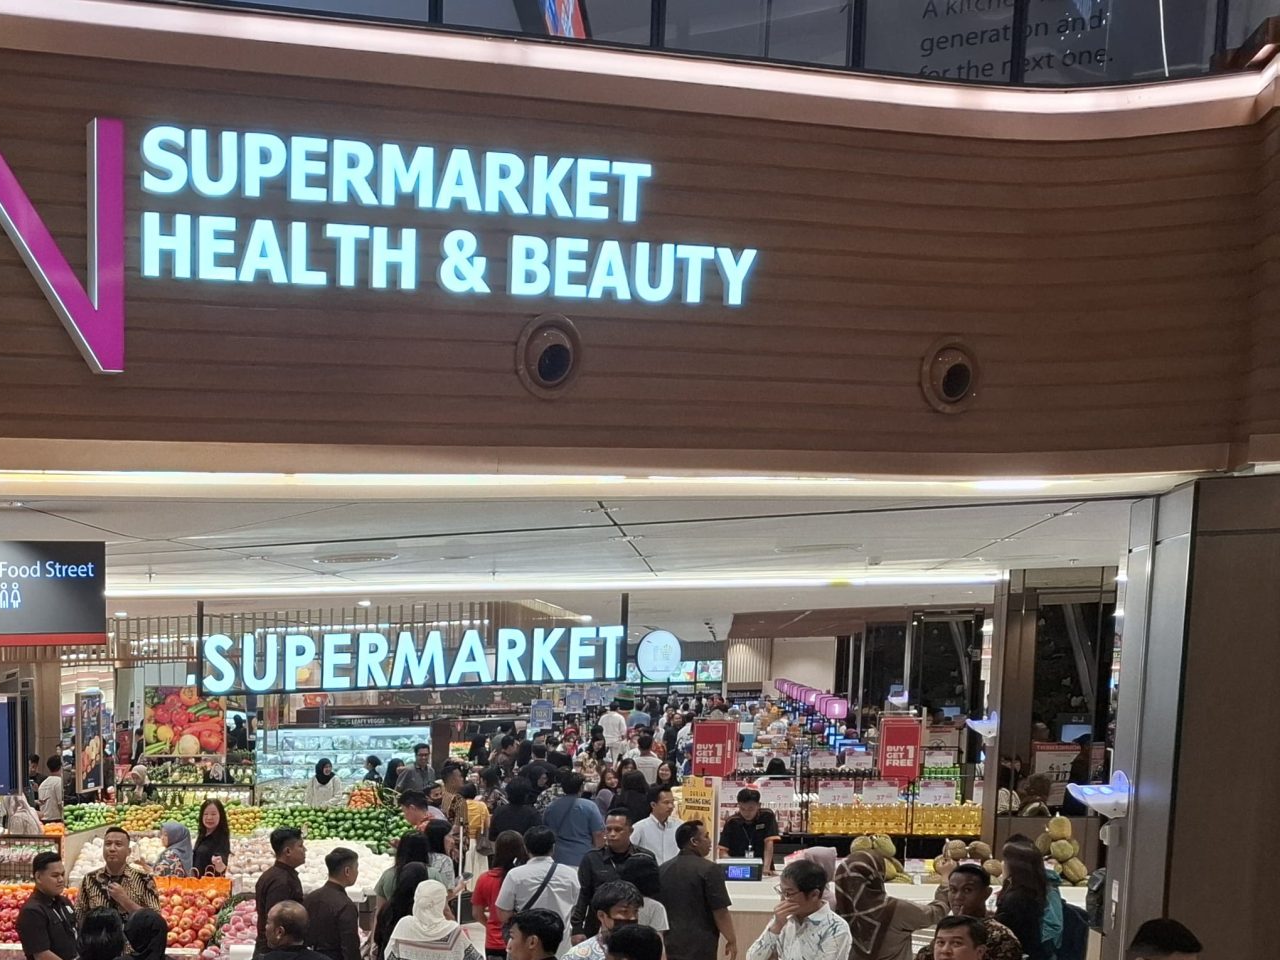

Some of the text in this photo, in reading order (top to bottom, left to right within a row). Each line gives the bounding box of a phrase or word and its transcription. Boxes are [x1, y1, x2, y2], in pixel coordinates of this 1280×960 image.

[1057, 9, 1103, 35] and
[957, 60, 994, 79] the
[140, 125, 653, 222] SUPERMARKET
[140, 211, 758, 306] HEALTH & BEAUTY
[0, 561, 42, 578] Food
[45, 561, 95, 578] Street
[201, 625, 625, 693] SUPERMARKET
[833, 704, 839, 715] 1
[715, 744, 722, 756] 1
[906, 745, 915, 759] 1
[886, 759, 914, 767] FREE
